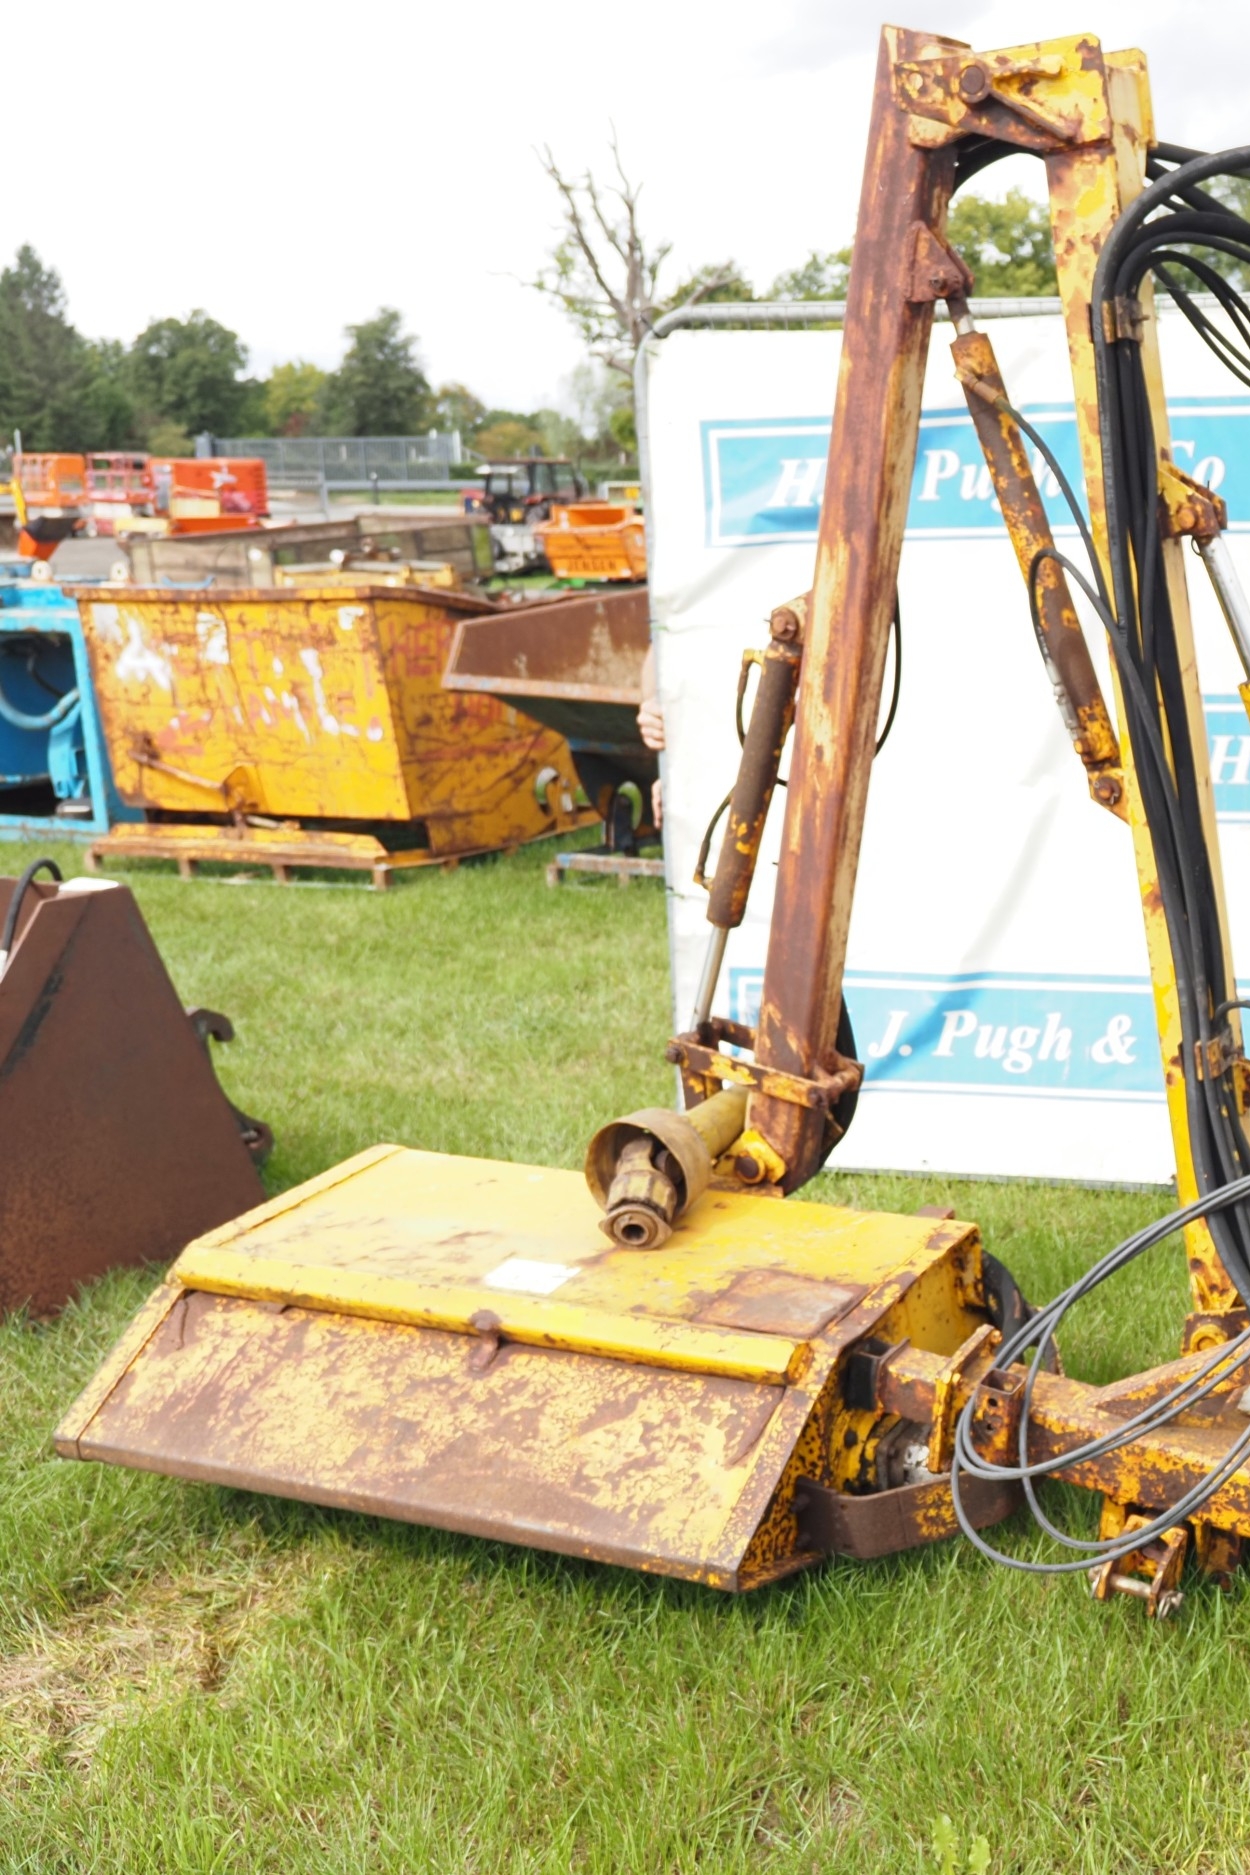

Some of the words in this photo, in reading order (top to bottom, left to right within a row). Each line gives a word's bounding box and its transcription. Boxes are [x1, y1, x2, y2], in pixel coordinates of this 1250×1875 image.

[867, 1008, 912, 1058] J.
[932, 1009, 1072, 1074] Pugh
[1091, 1013, 1138, 1065] &
